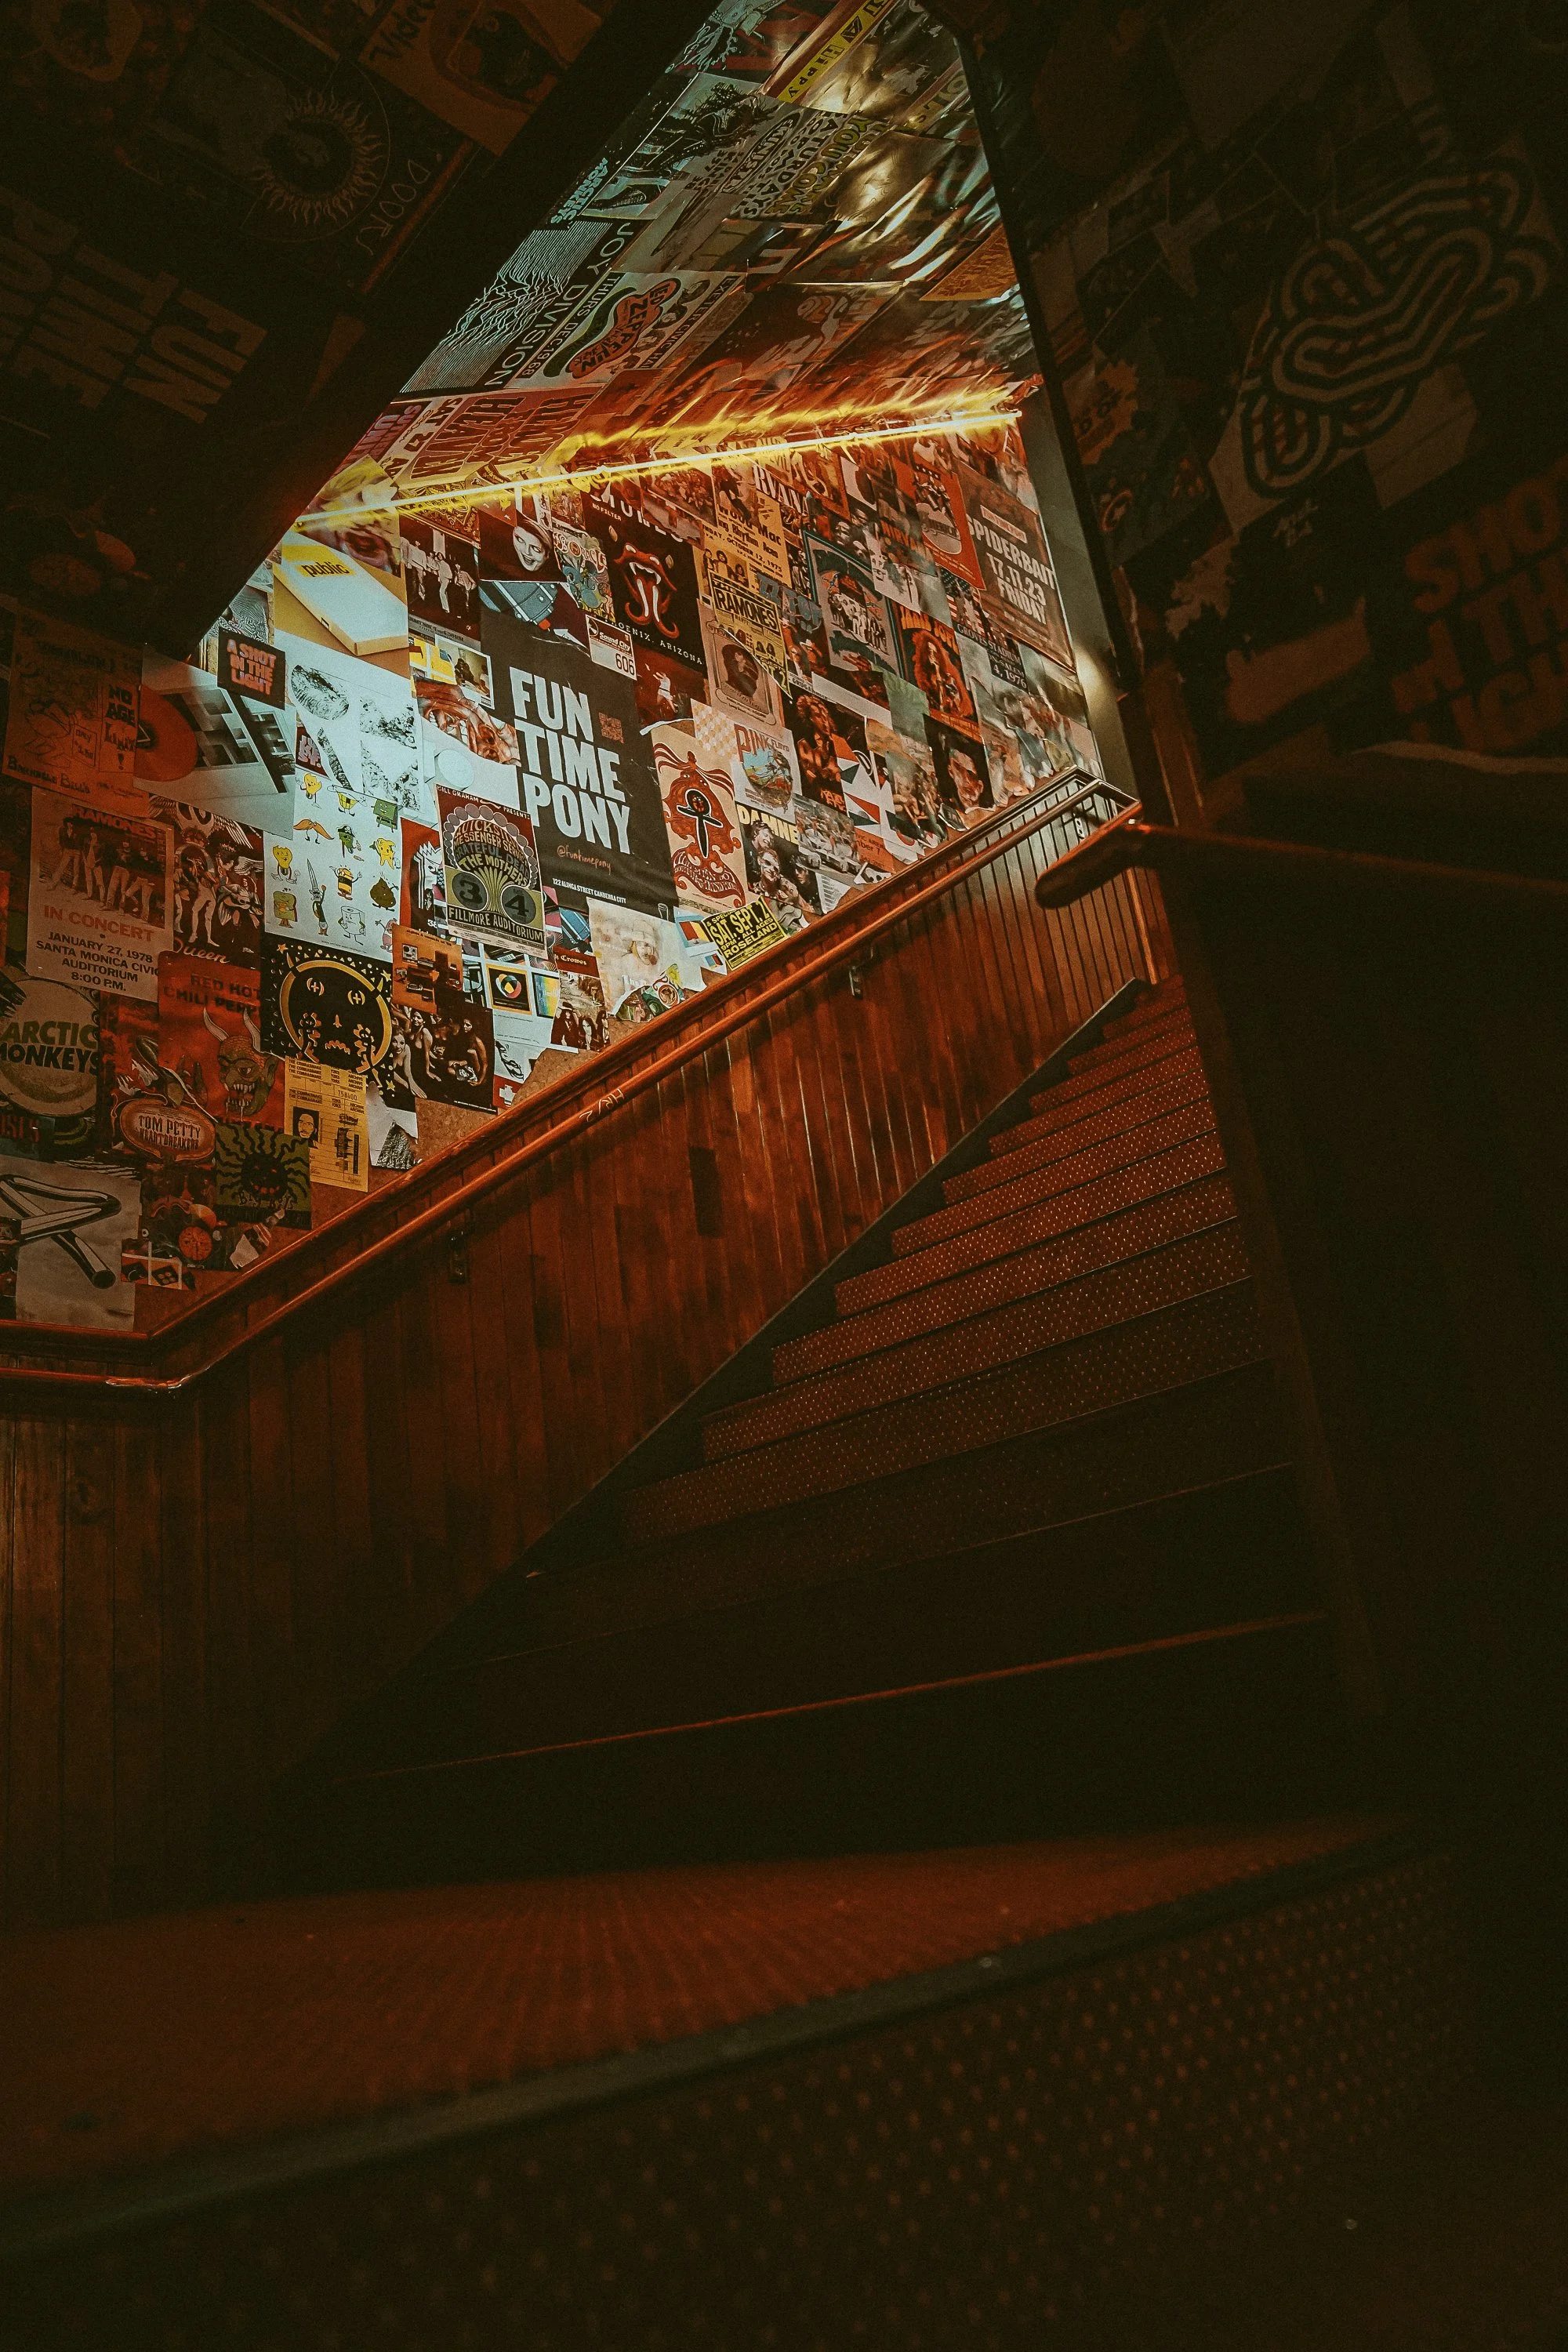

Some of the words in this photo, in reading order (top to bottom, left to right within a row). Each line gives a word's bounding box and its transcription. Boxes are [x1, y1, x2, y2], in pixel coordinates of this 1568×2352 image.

[356, 159, 432, 256] DOORS
[550, 158, 607, 224] MONKEYS
[565, 163, 609, 220] ARCTIC
[586, 222, 634, 275] JOY
[687, 277, 737, 322] EXETER
[7, 244, 179, 409] TIME
[492, 283, 588, 388] DIVISION
[660, 325, 690, 348] CIVIC
[122, 288, 268, 425] FUN
[424, 397, 461, 426] SAT
[491, 394, 594, 465] HEROES
[407, 397, 526, 479] HEAVEN
[464, 408, 535, 463] FROM
[753, 463, 811, 519] RVANA
[601, 506, 622, 521] FILTER
[757, 524, 782, 546] Mac
[966, 515, 1056, 590] SPIDERBAIT
[1404, 463, 1568, 613] SHO
[302, 561, 350, 578] public
[727, 537, 753, 557] OCTOBER
[767, 557, 782, 573] 1975
[986, 553, 1047, 606] 17.11.23
[717, 589, 779, 632] RAMONES
[997, 579, 1047, 625] FRIDAY
[1461, 547, 1568, 665] TH
[227, 638, 238, 655] A
[239, 642, 277, 664] SHOT
[599, 632, 619, 644] Sound
[619, 640, 630, 652] City
[660, 641, 702, 665] ARIZONA
[957, 623, 988, 649] GROVES
[988, 641, 1022, 666] STADIUM
[229, 654, 245, 671] IN
[246, 659, 274, 680] THE
[615, 652, 634, 676] 606
[1005, 670, 1027, 690] 1976
[230, 669, 272, 696] LIGHT
[509, 666, 593, 742] FUN
[515, 717, 625, 802] TIME
[734, 724, 769, 764] PINK
[437, 785, 451, 796] BILL
[452, 789, 479, 803] GRAHAM
[74, 804, 157, 840] RAMONES
[521, 772, 630, 855] PONY
[454, 830, 502, 848] MESSENGER
[455, 841, 503, 860] GRATEFUL
[506, 855, 531, 881] DEAD
[459, 852, 483, 872] THE
[485, 854, 529, 887] MOTHERS
[557, 844, 612, 876] @funtimepony
[459, 880, 483, 902] 3
[504, 894, 528, 917] 4
[552, 877, 561, 886] 122
[576, 884, 594, 895] STREET
[617, 895, 626, 904] CITY
[44, 905, 63, 920] IN
[68, 911, 154, 942] CONCERT
[448, 907, 490, 926] FILLMORE
[492, 914, 544, 942] AUDITORIUM
[710, 919, 738, 946] SAT.
[729, 905, 763, 933] SEPT.
[757, 902, 770, 920] 2
[720, 939, 737, 952] 9PM
[742, 927, 756, 938] ALL
[756, 918, 774, 931] AGES
[722, 922, 779, 959] ROSELAND
[36, 940, 77, 957] SANTA
[80, 949, 128, 969] MONICA
[48, 932, 103, 952] JANUARY
[107, 946, 123, 957] 27,
[126, 950, 153, 964] 1978
[173, 936, 230, 964] Queen
[62, 957, 138, 982] AUDITORIUM
[71, 971, 101, 986] 8:00
[103, 978, 127, 992] P.M.
[191, 973, 224, 991] RED
[229, 982, 260, 1000] HOT
[163, 985, 209, 1005] CHILI
[1, 1021, 99, 1051] ARCTIC
[139, 1115, 163, 1134] TOM
[166, 1120, 201, 1138] PETTY
[140, 1128, 200, 1151] HEARTBREAKERS
